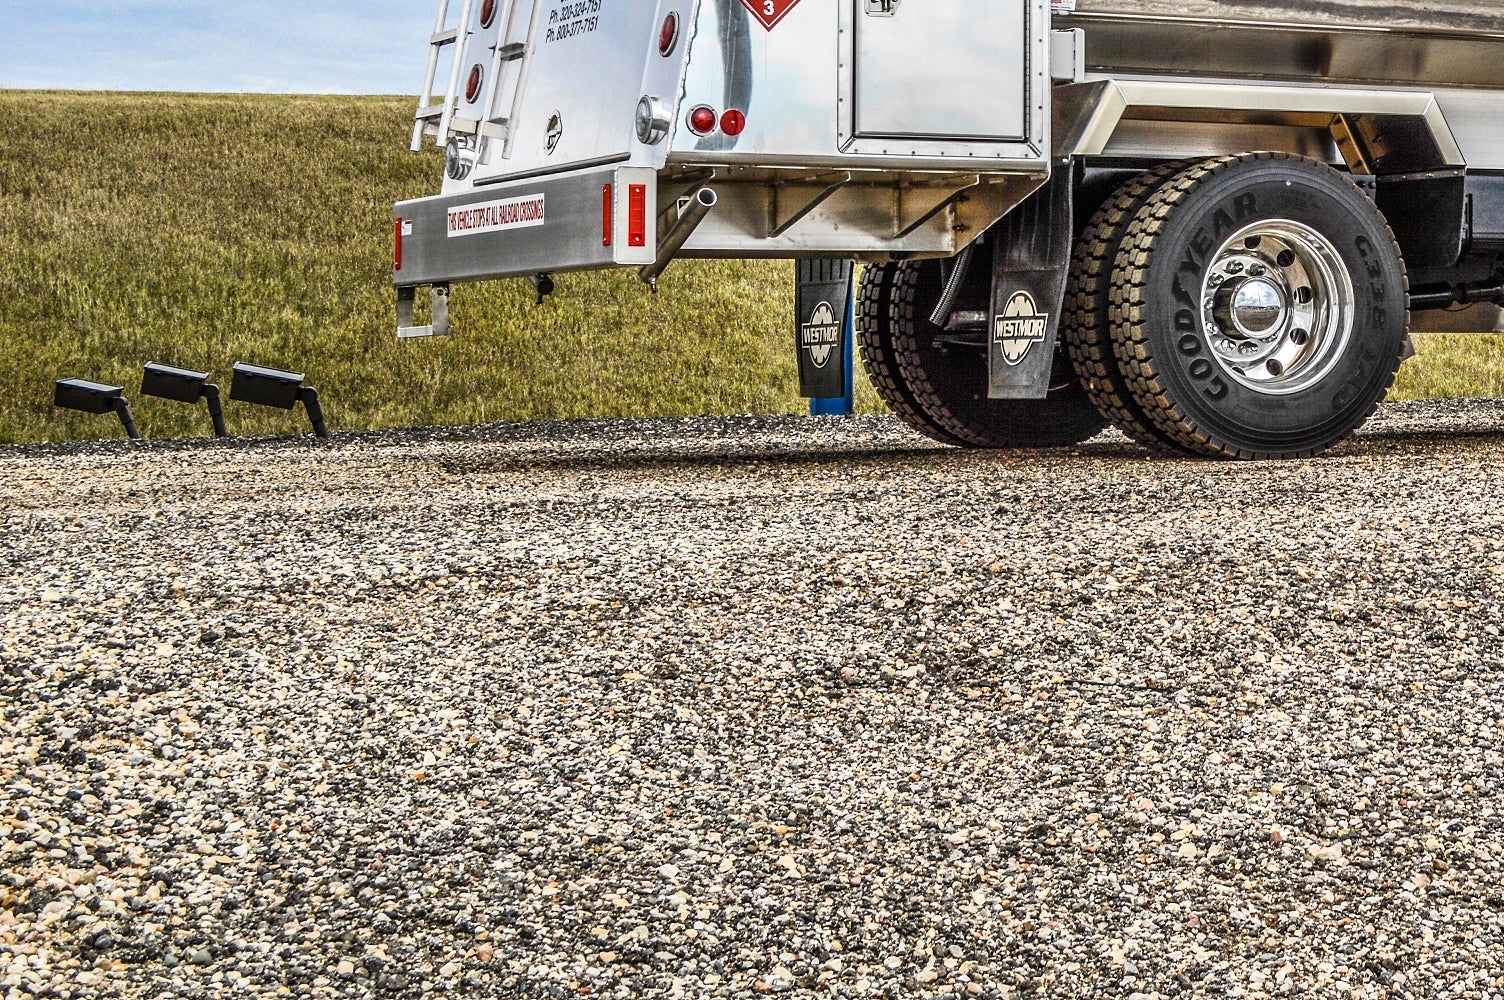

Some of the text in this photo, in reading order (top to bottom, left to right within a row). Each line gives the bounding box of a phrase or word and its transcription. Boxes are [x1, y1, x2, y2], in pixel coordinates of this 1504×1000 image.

[548, 9, 559, 25] Ph.
[763, 0, 775, 16] 3
[545, 15, 599, 44] Ph. 800-377-7151
[448, 199, 544, 231] THIS VEHICLE STOPS AT ALL RAILROAD CROSSINGS
[1171, 192, 1257, 400] GOODYEAR
[803, 326, 838, 343] WESTMOR
[996, 318, 1045, 338] WESTMOR
